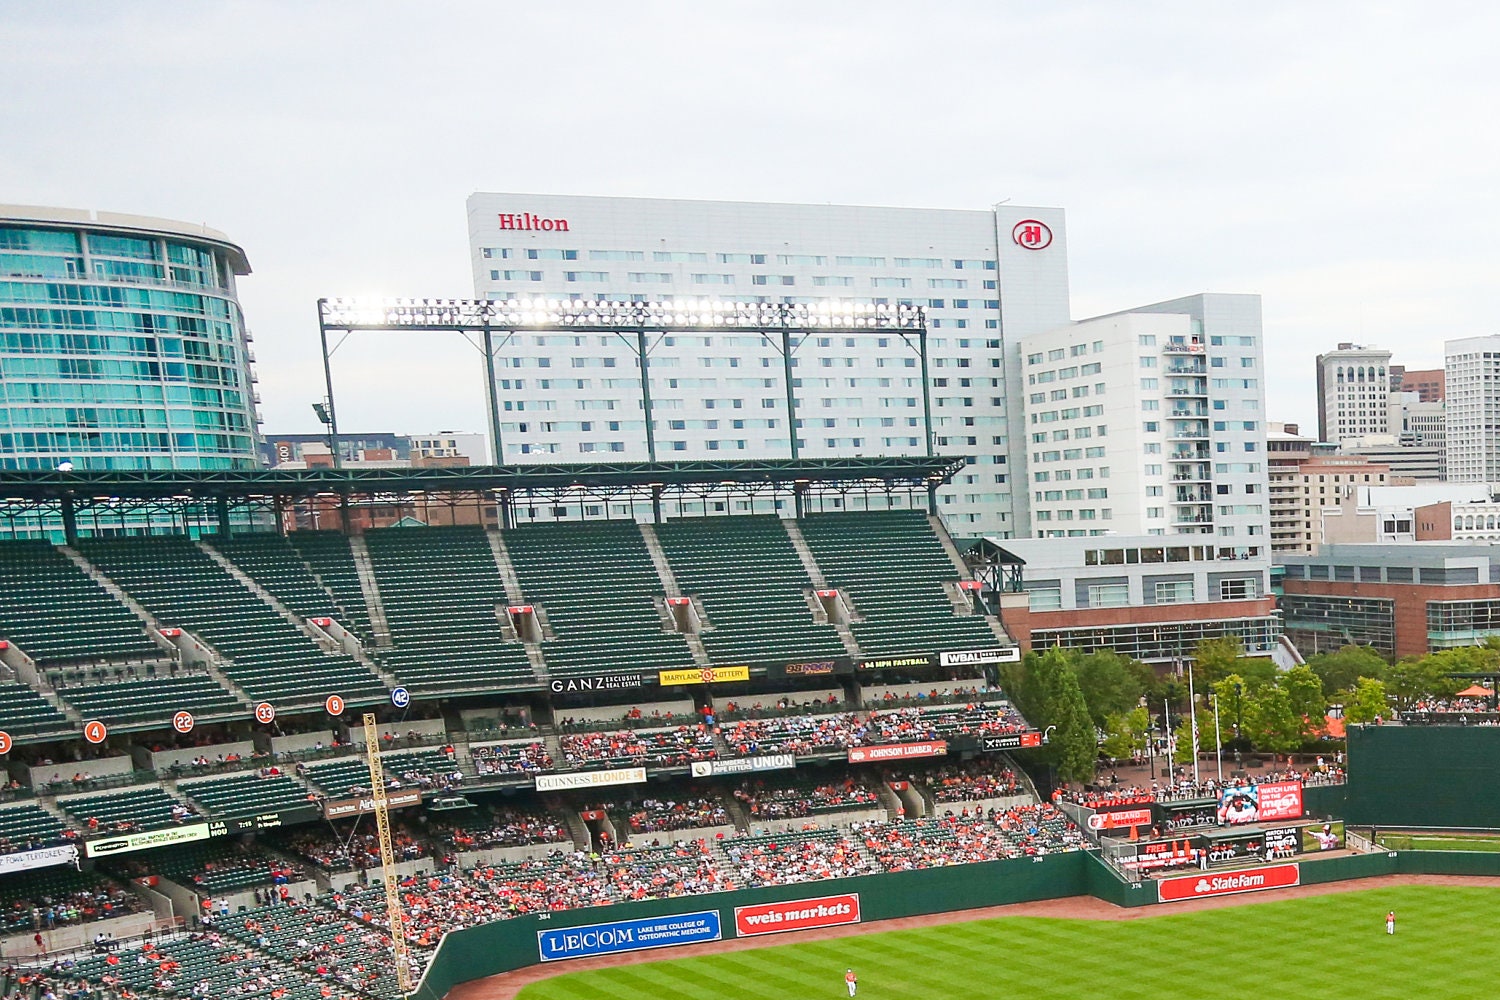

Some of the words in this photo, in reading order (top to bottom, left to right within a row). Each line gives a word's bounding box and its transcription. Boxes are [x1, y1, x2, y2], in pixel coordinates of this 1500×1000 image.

[498, 212, 569, 231] Hilton
[875, 660, 892, 668] MPH
[892, 657, 929, 667] FASTBALL
[949, 653, 981, 663] WBAL
[664, 673, 700, 681] MARYLAND
[716, 670, 744, 679] LOTTERY
[551, 677, 605, 692] GANZ
[605, 675, 641, 683] EXCLUSIVE
[395, 692, 406, 702] 42
[332, 700, 339, 710] 8
[259, 708, 273, 719] 33
[177, 717, 191, 728] 22
[91, 726, 100, 739] 4
[869, 748, 903, 758] JOHNSON
[904, 745, 932, 756] LUMBER
[713, 759, 746, 767] PLUMBERS
[753, 754, 793, 768] UNION
[726, 764, 752, 772] FITTERS
[538, 775, 590, 789] GUINNESS
[592, 771, 631, 783] BLONDE
[1260, 786, 1283, 794] WATCH
[1262, 809, 1277, 817] APP
[210, 821, 225, 829] LAA
[210, 828, 227, 837] HOU
[1146, 844, 1167, 853] FREE
[745, 909, 783, 925] weis
[785, 902, 851, 921] markets
[637, 926, 654, 934] LAKE
[654, 924, 668, 932] ERIE
[668, 921, 696, 930] COLLEGE
[638, 930, 680, 941] OSTEOPATHIC
[680, 926, 711, 936] MEDICINE
